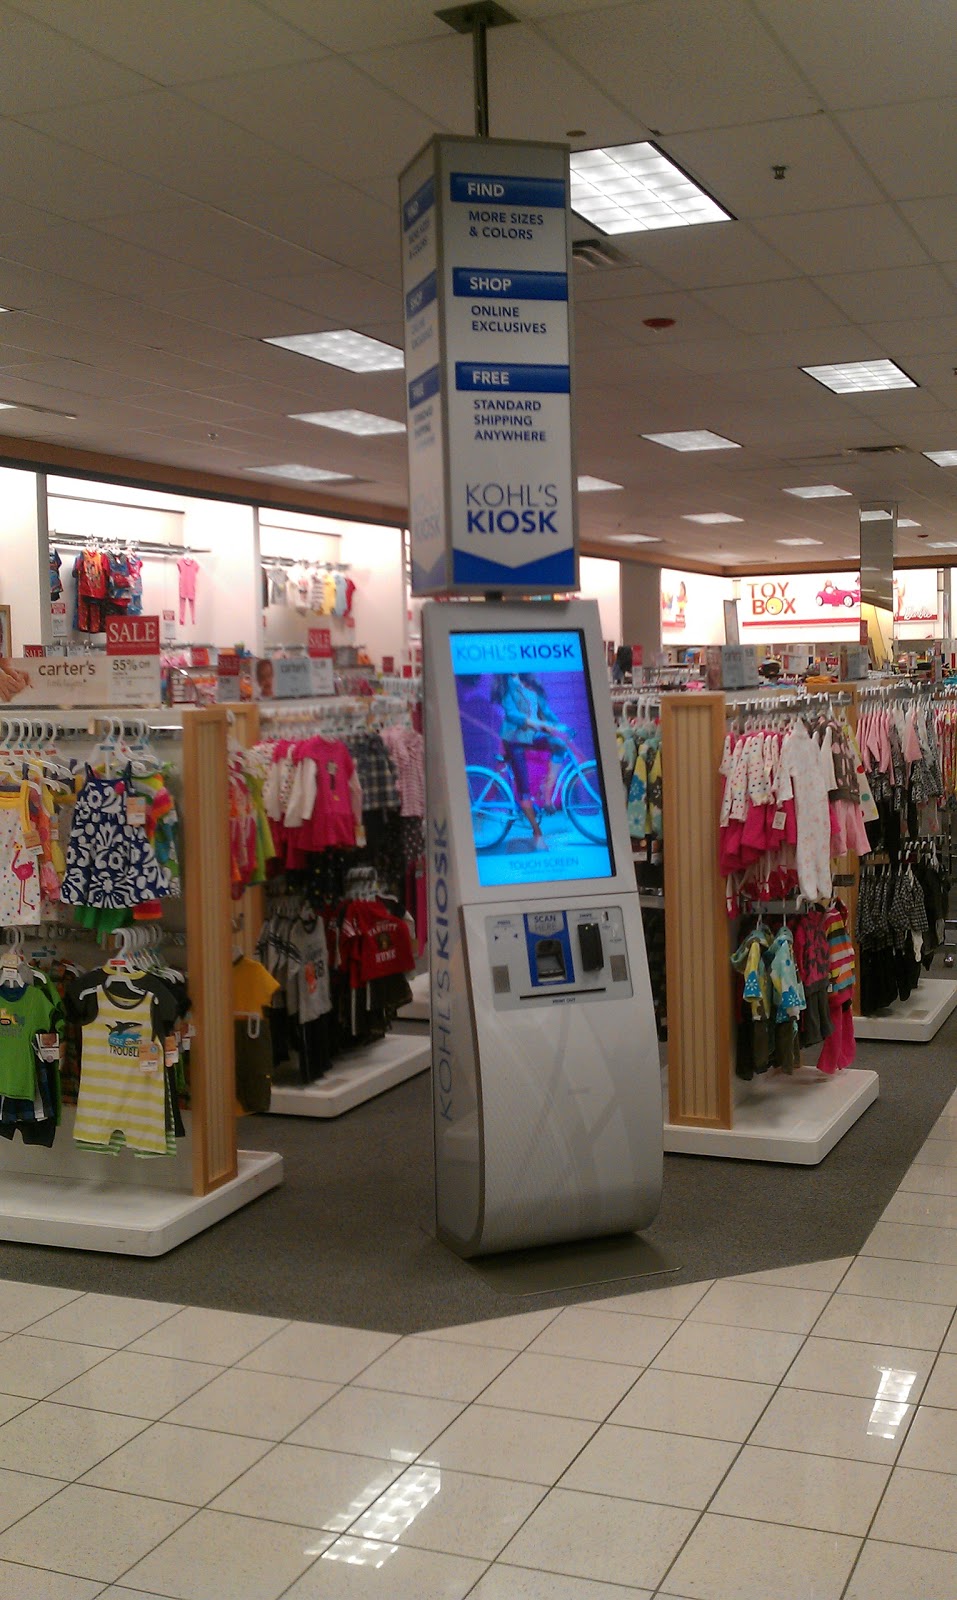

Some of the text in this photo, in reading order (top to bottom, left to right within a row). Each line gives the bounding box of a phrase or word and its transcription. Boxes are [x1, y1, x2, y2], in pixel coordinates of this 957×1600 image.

[467, 182, 505, 197] FIND
[469, 210, 544, 225] MORE SIZES
[469, 226, 533, 240] & COLORS
[470, 276, 512, 292] SHOP
[471, 305, 520, 318] ONLINE
[472, 321, 547, 334] EXCLUSIVES
[472, 370, 510, 385] FREE
[474, 399, 542, 412] STANDARD
[474, 415, 533, 427] SHIPPING
[474, 430, 547, 442] ANYWHERE
[466, 483, 558, 508] KOHL'S
[467, 509, 559, 535] KIOSK
[747, 582, 789, 599] TOY
[752, 597, 796, 616] BOX
[109, 622, 156, 643] SALE
[456, 645, 575, 661] KOHL'S KIOSK
[38, 660, 96, 676] carter's
[112, 659, 137, 671] 55%
[534, 915, 556, 923] SCAN
[434, 818, 453, 1121] KOHL'S KIOSK
[109, 1045, 140, 1057] TROUBL
